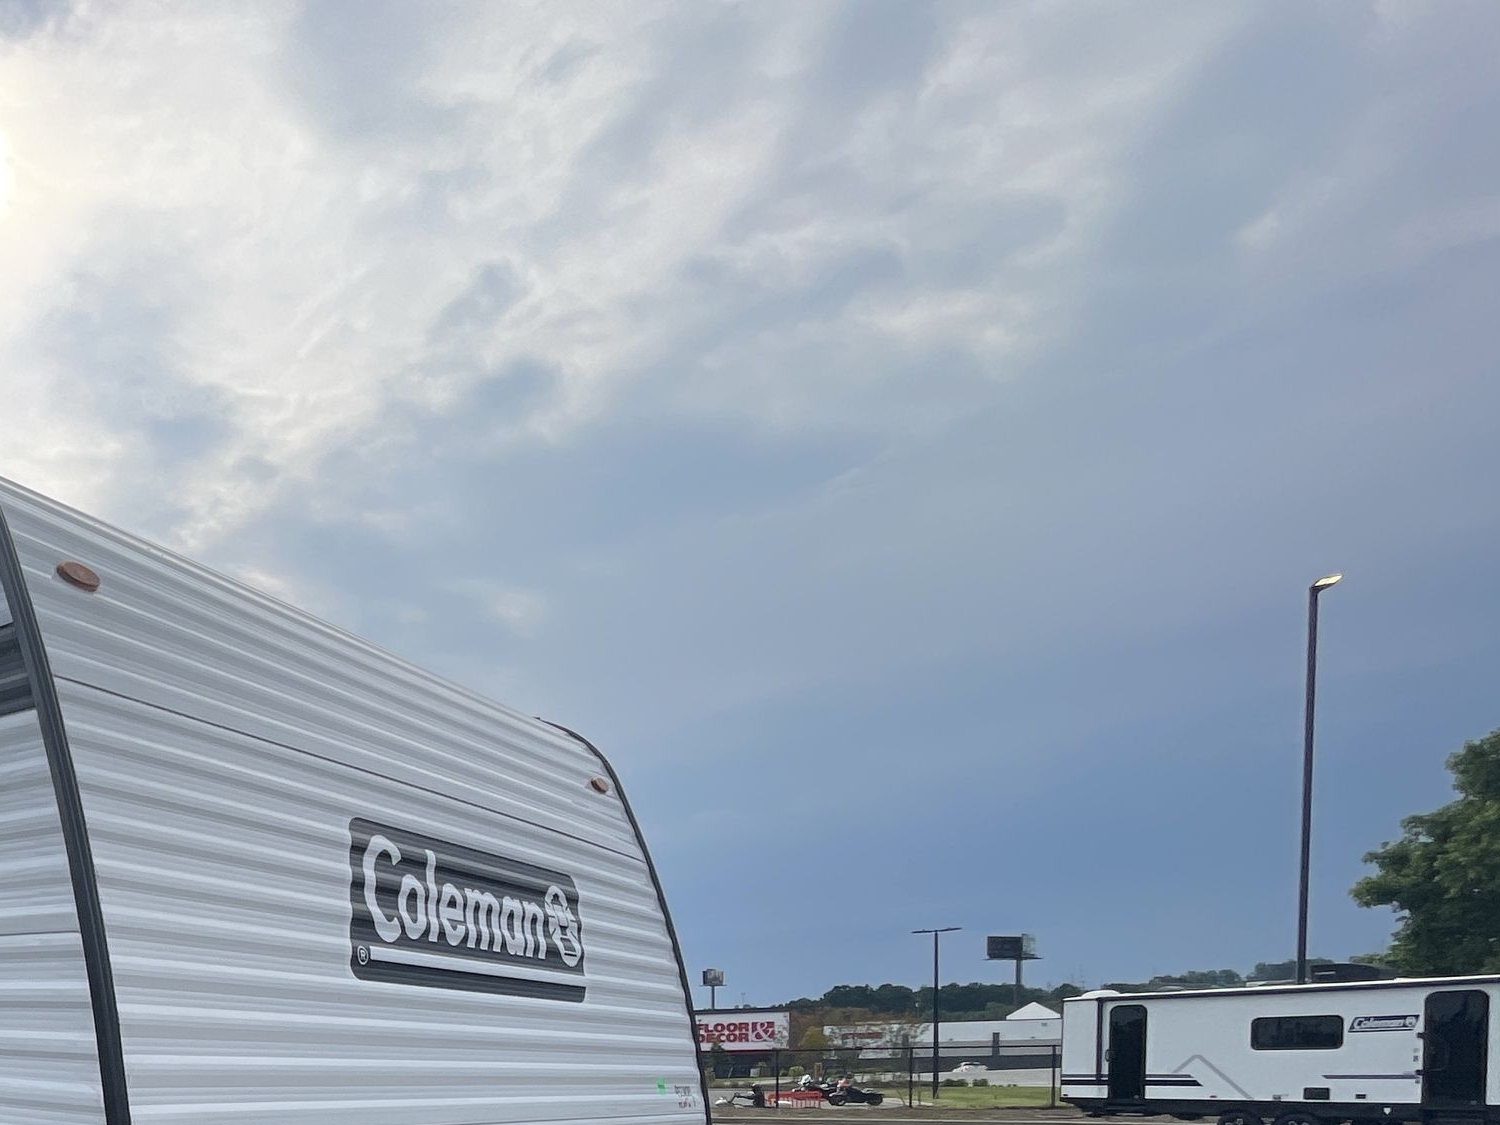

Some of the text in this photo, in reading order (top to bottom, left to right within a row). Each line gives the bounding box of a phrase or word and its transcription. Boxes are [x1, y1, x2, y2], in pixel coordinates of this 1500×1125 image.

[362, 834, 547, 960] Coleman
[696, 1021, 750, 1033] FLOOR
[697, 1032, 750, 1043] DECOR
